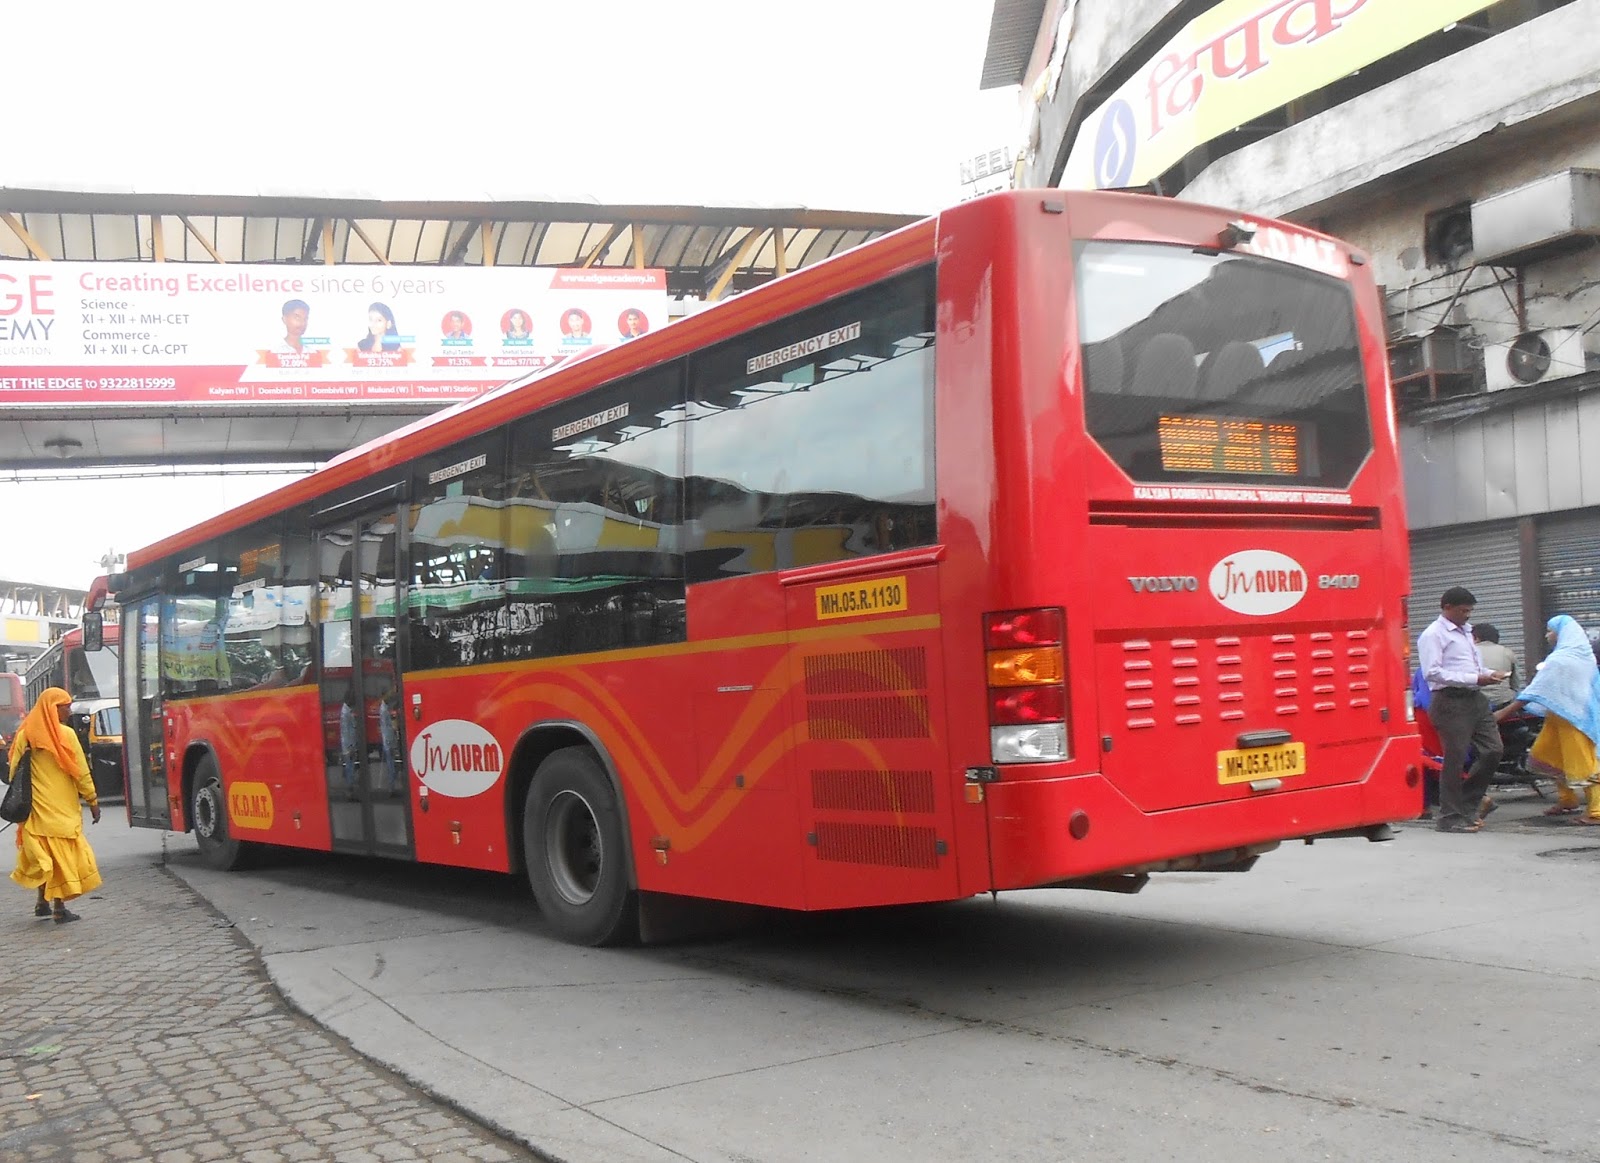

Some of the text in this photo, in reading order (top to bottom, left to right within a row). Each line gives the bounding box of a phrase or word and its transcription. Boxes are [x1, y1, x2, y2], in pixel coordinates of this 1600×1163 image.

[959, 146, 1013, 185] NEEL
[79, 272, 445, 298] Creating Excellence since 6 years
[80, 299, 128, 310] Science
[82, 313, 94, 324] XI
[109, 314, 125, 324] XII
[140, 314, 190, 325] MH-CET
[82, 329, 151, 340] Commerce
[0, 346, 51, 356] UCATION
[83, 344, 97, 355] XI
[111, 344, 127, 355] XII
[142, 344, 188, 355] CA-CPT
[747, 323, 860, 373] EMERGENCY EXIT
[0, 377, 176, 390] ET THE EDGE to 9322815999
[209, 386, 234, 396] Kalyan
[235, 386, 249, 396] (W)
[344, 386, 358, 395] (W)
[367, 385, 394, 394] Mulund
[395, 385, 409, 394] (W)
[417, 385, 439, 394] Thane
[453, 385, 478, 393] Station
[553, 404, 629, 440] EMERGENCY EXIT
[469, 455, 487, 469] EXIT
[1134, 486, 1171, 500] KALYAN
[1127, 576, 1199, 593] VOLVO
[1318, 574, 1360, 589] 8400
[232, 794, 270, 818] K.D.M.T.
